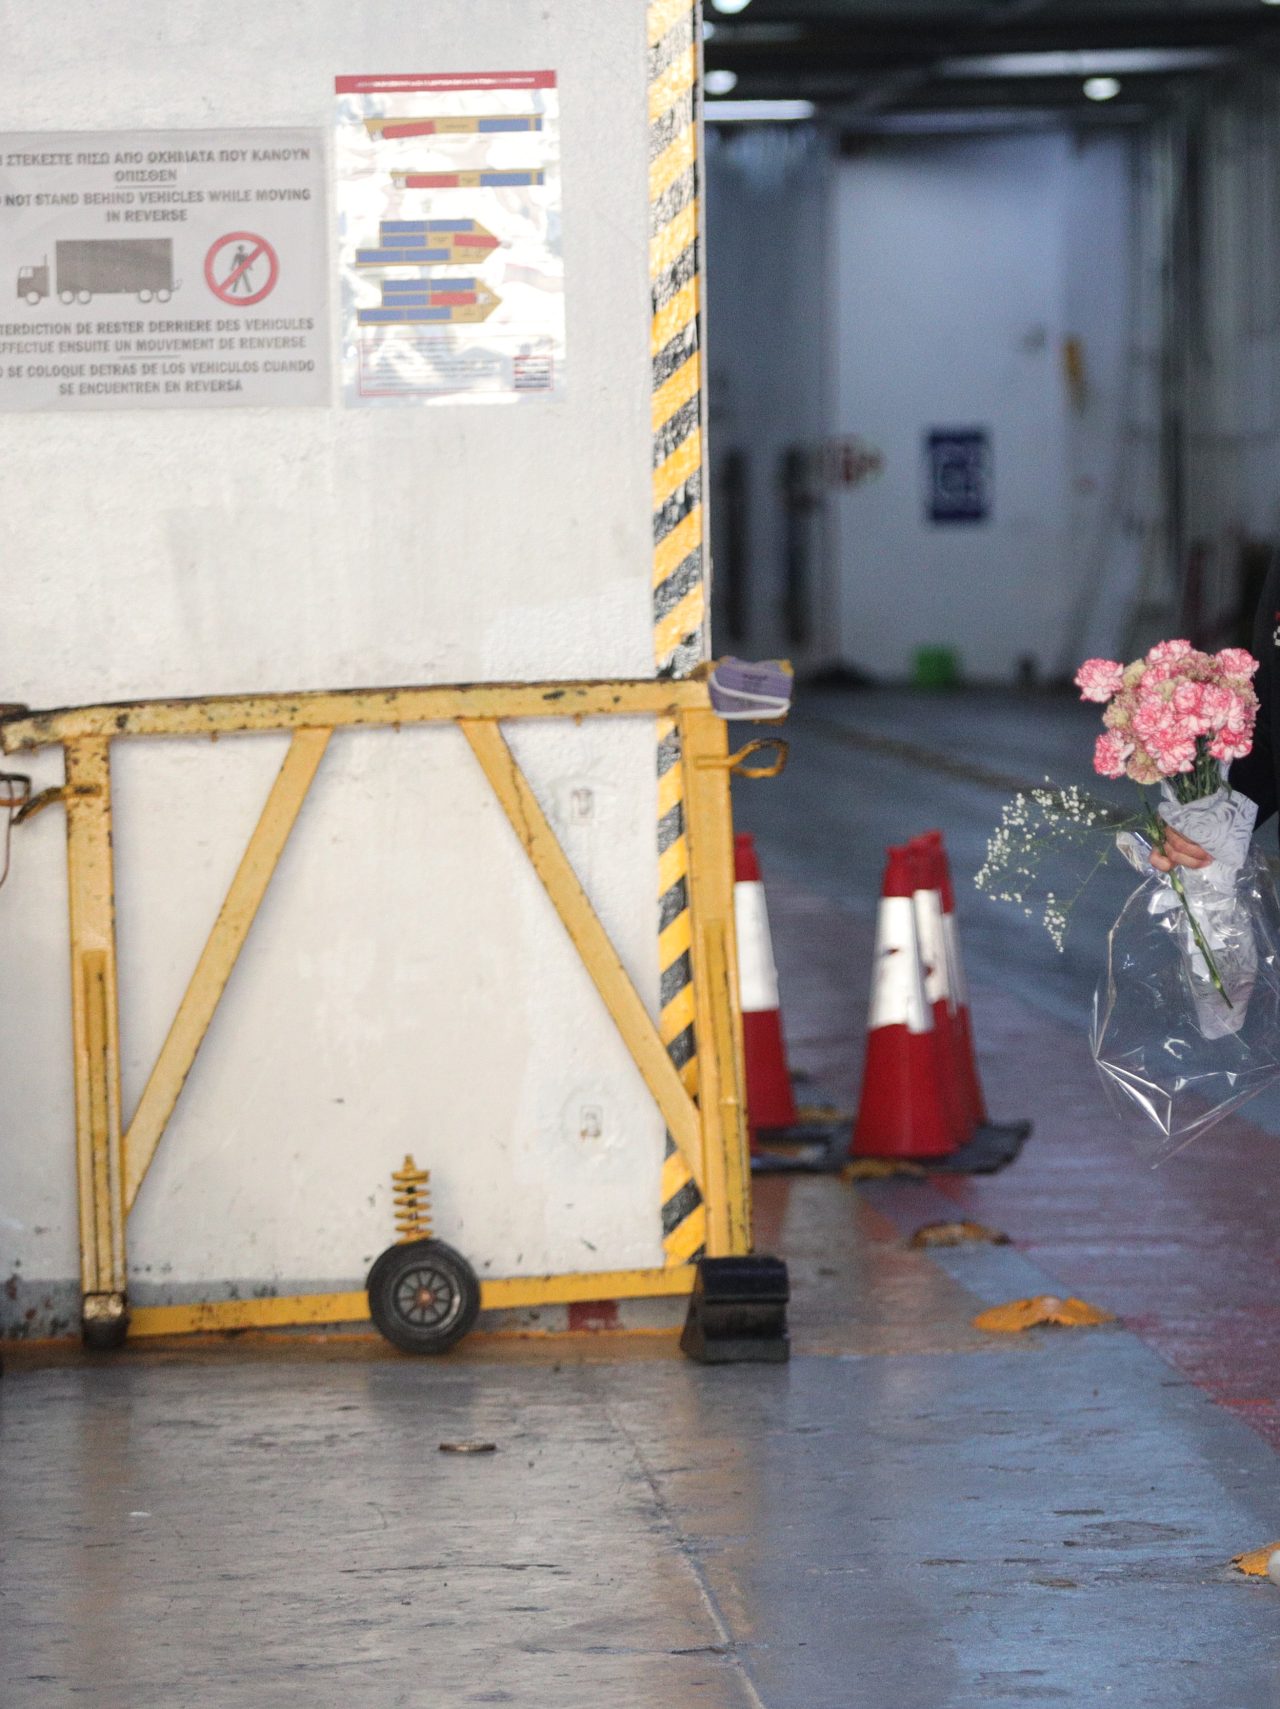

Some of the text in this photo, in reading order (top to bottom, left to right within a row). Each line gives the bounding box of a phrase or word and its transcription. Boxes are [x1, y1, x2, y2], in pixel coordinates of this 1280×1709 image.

[6, 153, 73, 166] ΣΤΕΚΕΣΤΕ
[77, 152, 110, 165] ΠΙΣΩ
[114, 151, 143, 164] ΑΠΟ
[147, 150, 215, 163] ΟΧΗΜΑΤΑ
[219, 150, 249, 162] ΠΟΥ
[252, 148, 311, 161] ΚΑΝΟΥΝ
[114, 169, 177, 182] ΟΠΙΣΘΕΝ
[5, 193, 32, 206] NOT
[35, 193, 79, 206] STAND
[83, 192, 135, 205] BEHIND
[139, 190, 205, 203] VEHICLES
[208, 189, 252, 202] WHILE
[255, 188, 311, 201] MOVING
[106, 209, 188, 223] IN REVERSE
[76, 322, 93, 334] DE
[97, 321, 144, 334] RESTER
[149, 320, 212, 333] DERRIERE
[217, 319, 241, 331] DES
[245, 317, 314, 331] VEHICULES
[0, 336, 307, 354] FFECTUE ENSUITE UN MOUVEMENT DE RENVERSE
[8, 365, 25, 378] SE
[27, 364, 87, 378] COLOQUE
[90, 363, 138, 376] DETRAS
[142, 363, 158, 375] DE
[162, 362, 186, 374] LOS
[190, 361, 260, 373] VEHICULOS
[264, 360, 316, 372] CUANDO
[59, 379, 243, 395] SE ENCUENTREN EN REVERSA
